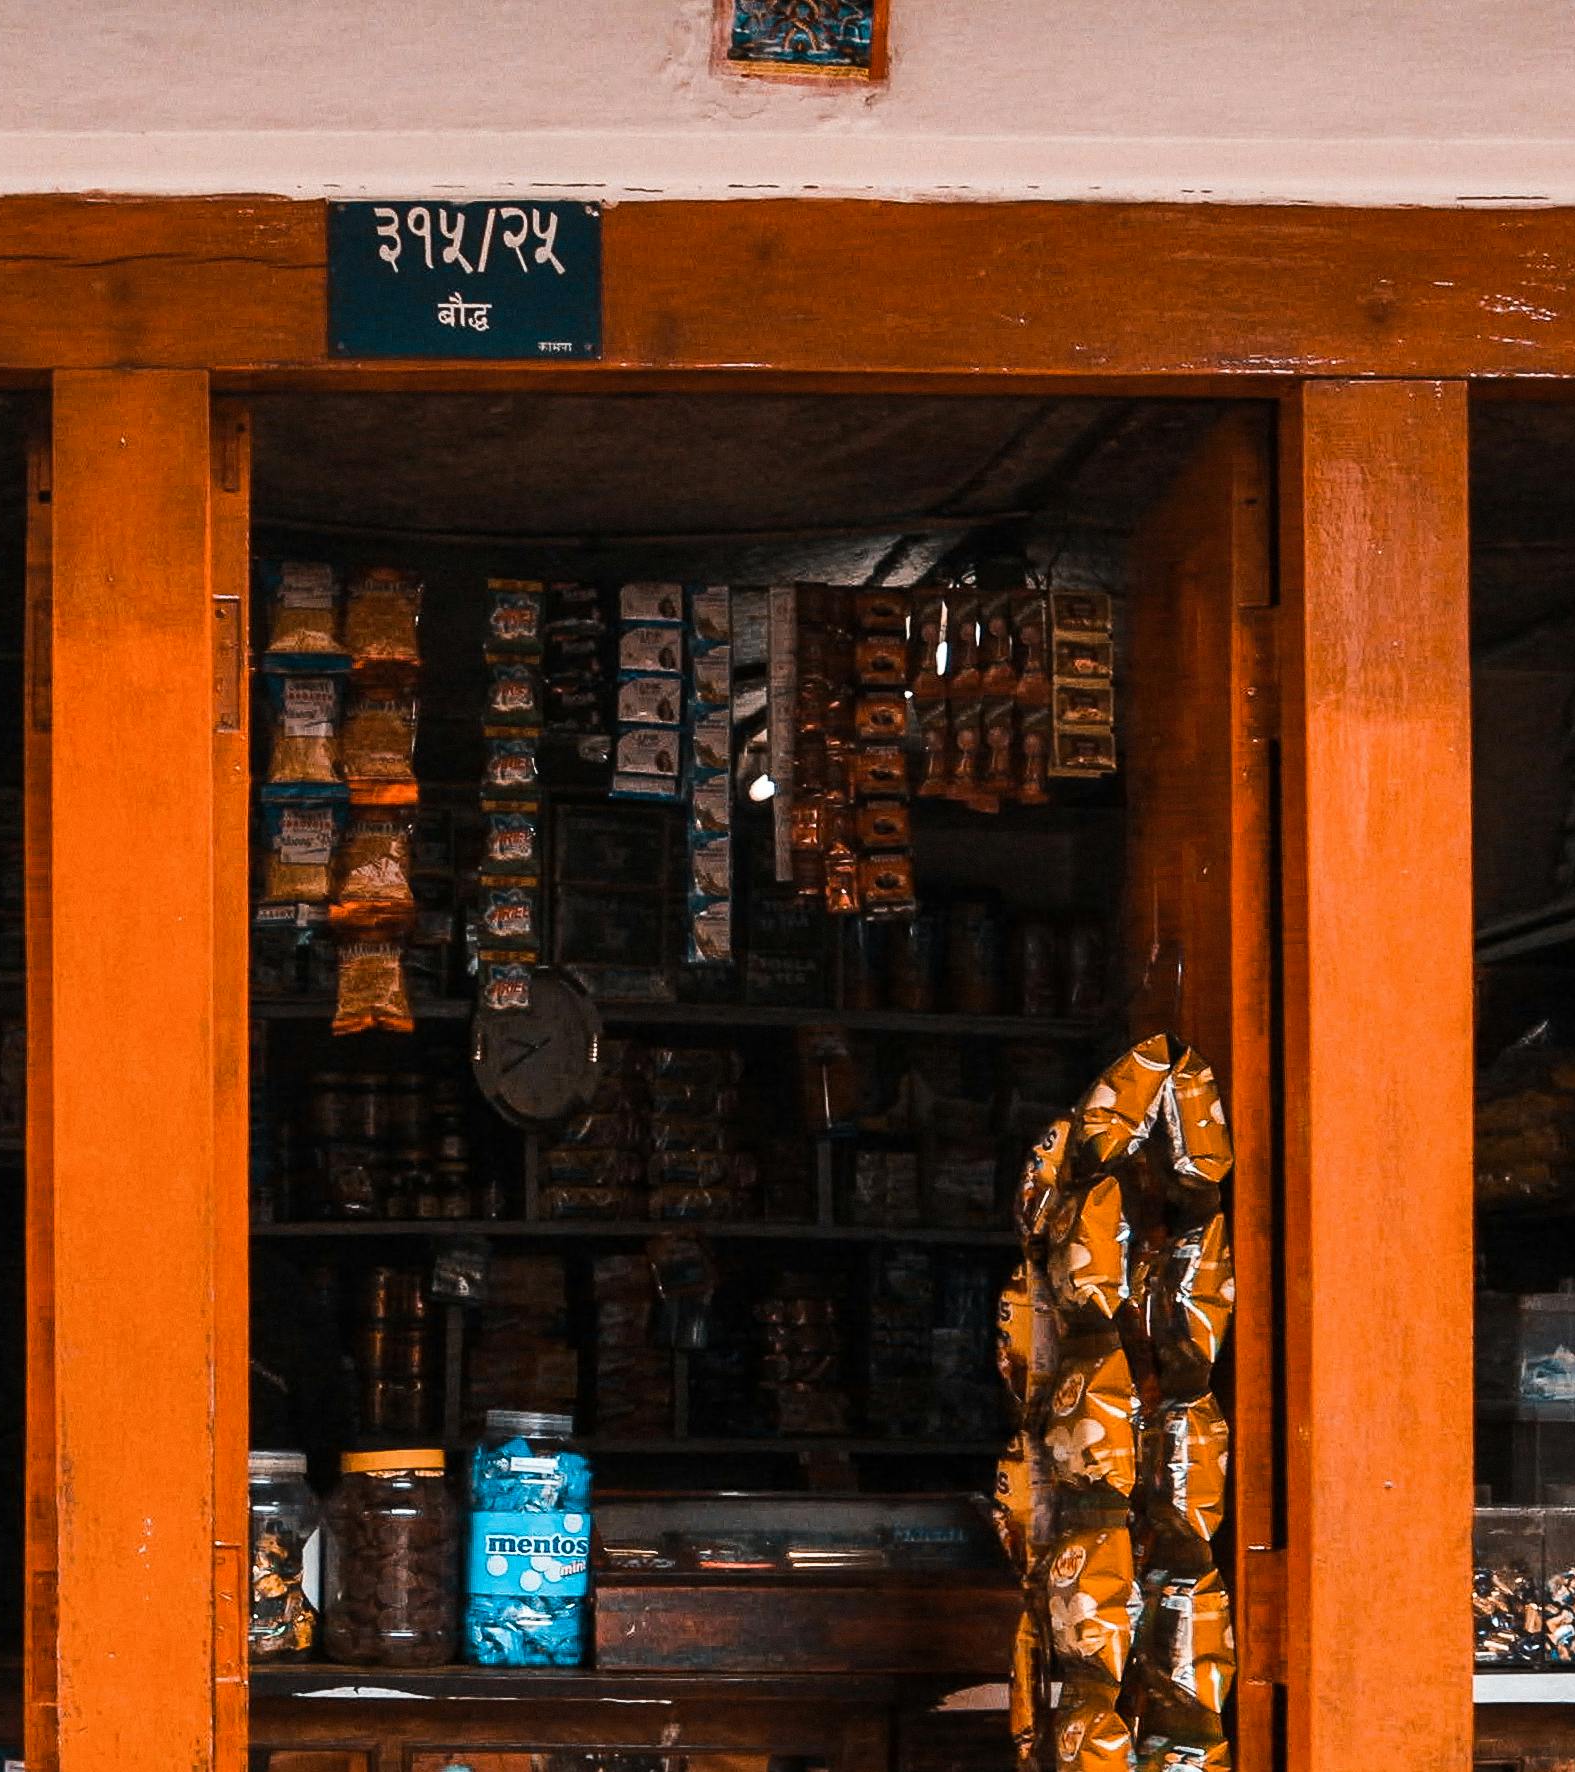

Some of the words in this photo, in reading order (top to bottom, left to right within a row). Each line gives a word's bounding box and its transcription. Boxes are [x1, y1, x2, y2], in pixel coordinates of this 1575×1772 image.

[373, 205, 566, 275] ३१५/२५
[437, 291, 493, 332] बौद्ध
[486, 1534, 589, 1556] mentos
